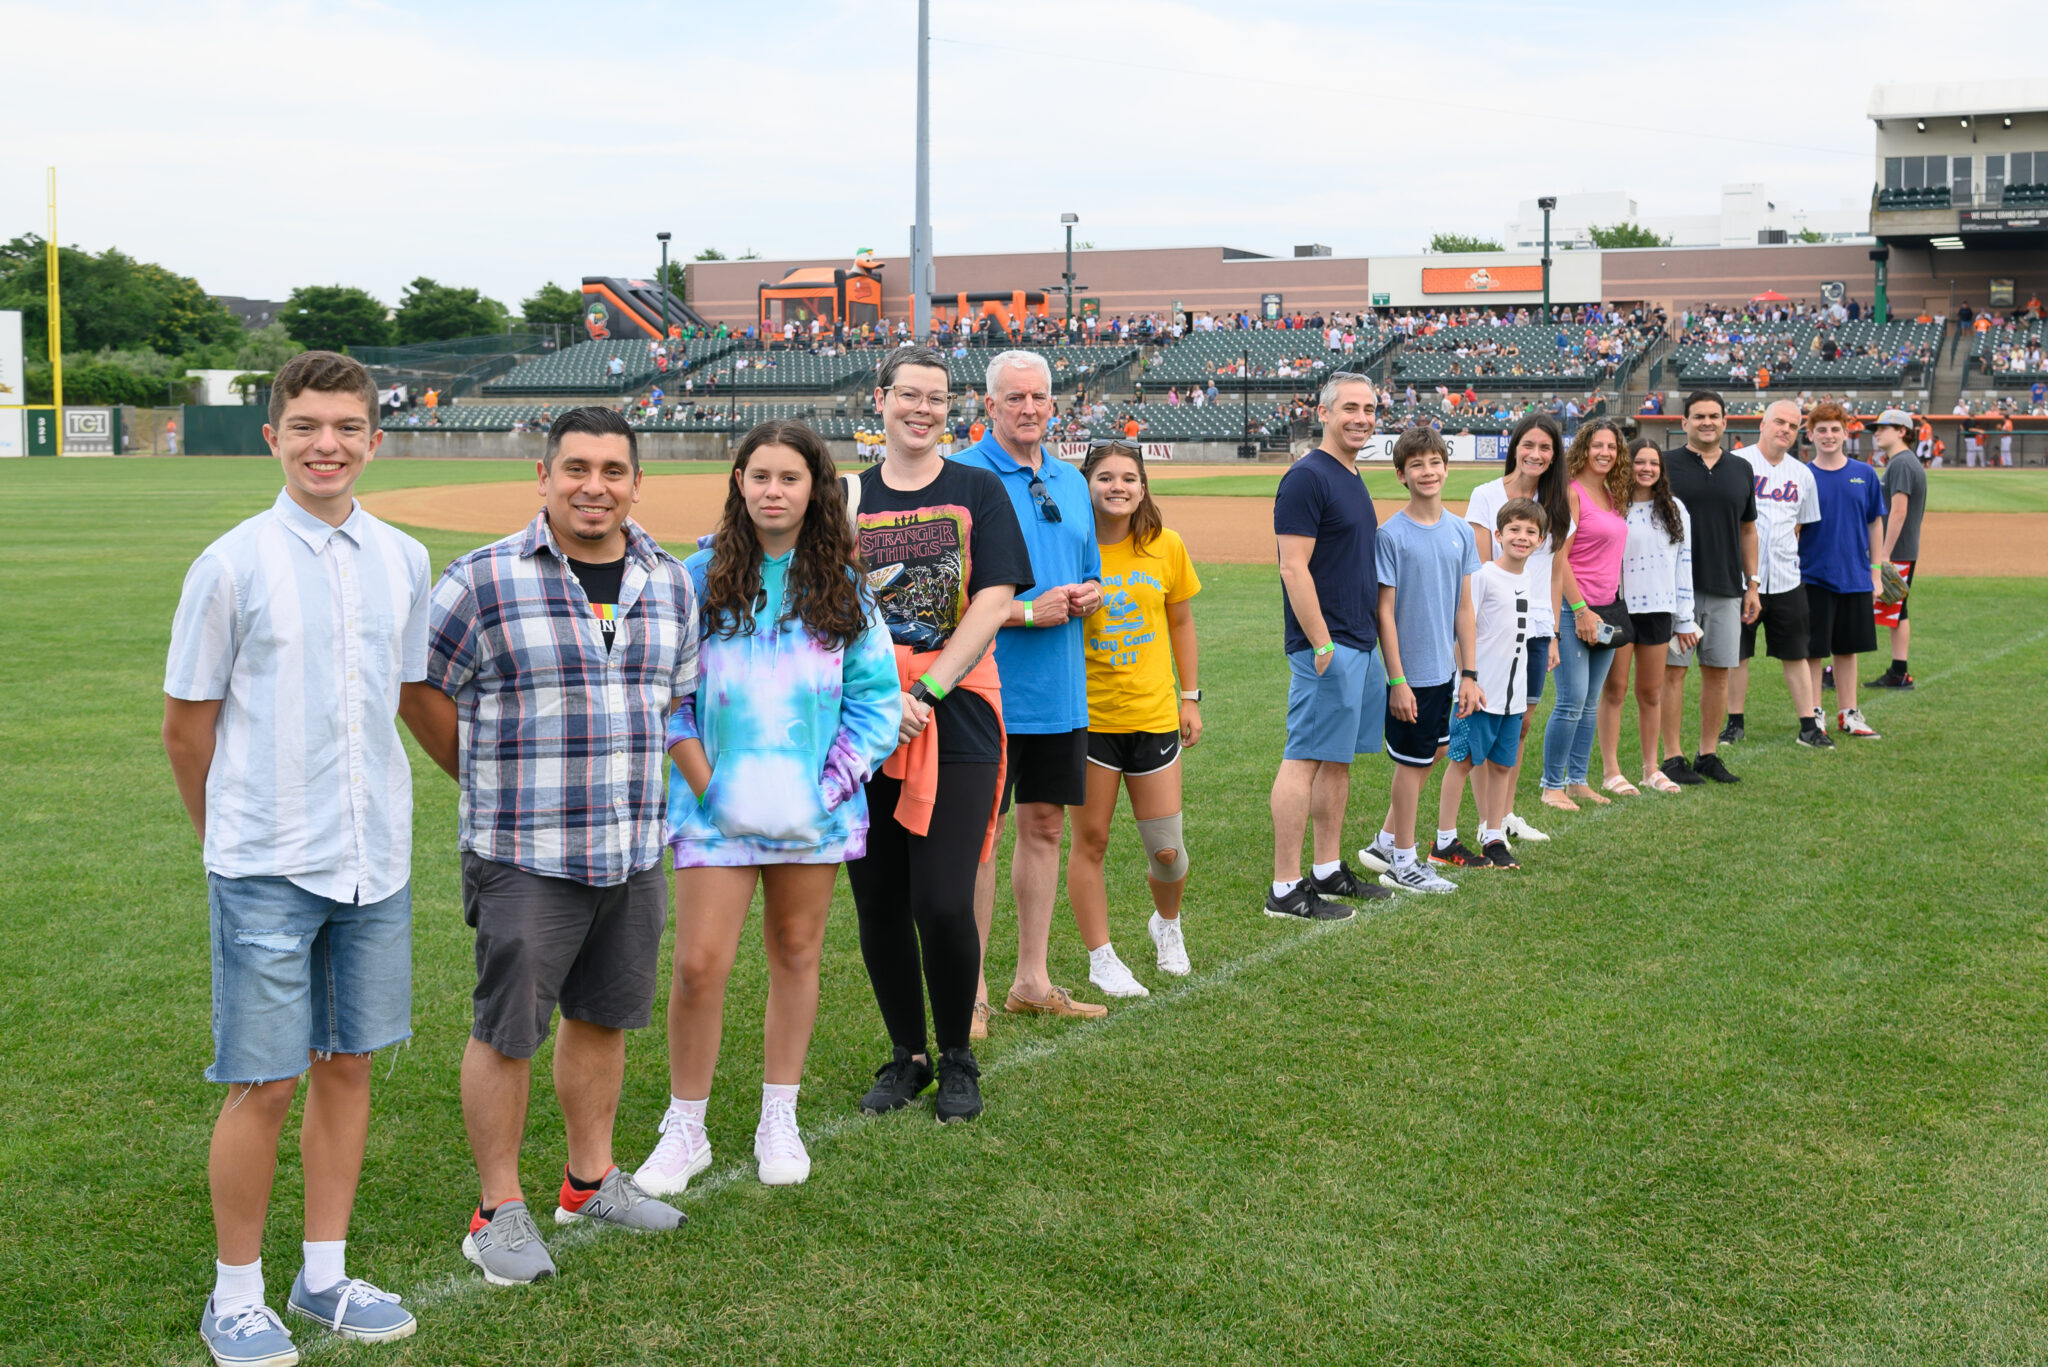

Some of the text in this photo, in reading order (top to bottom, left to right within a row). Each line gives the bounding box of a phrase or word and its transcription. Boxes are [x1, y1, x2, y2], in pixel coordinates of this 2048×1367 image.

[37, 416, 47, 445] 325
[71, 414, 104, 432] TGI
[1147, 444, 1172, 459] INN
[860, 525, 956, 553] STRANGER
[875, 541, 942, 564] THINGS
[1110, 650, 1139, 667] CIT
